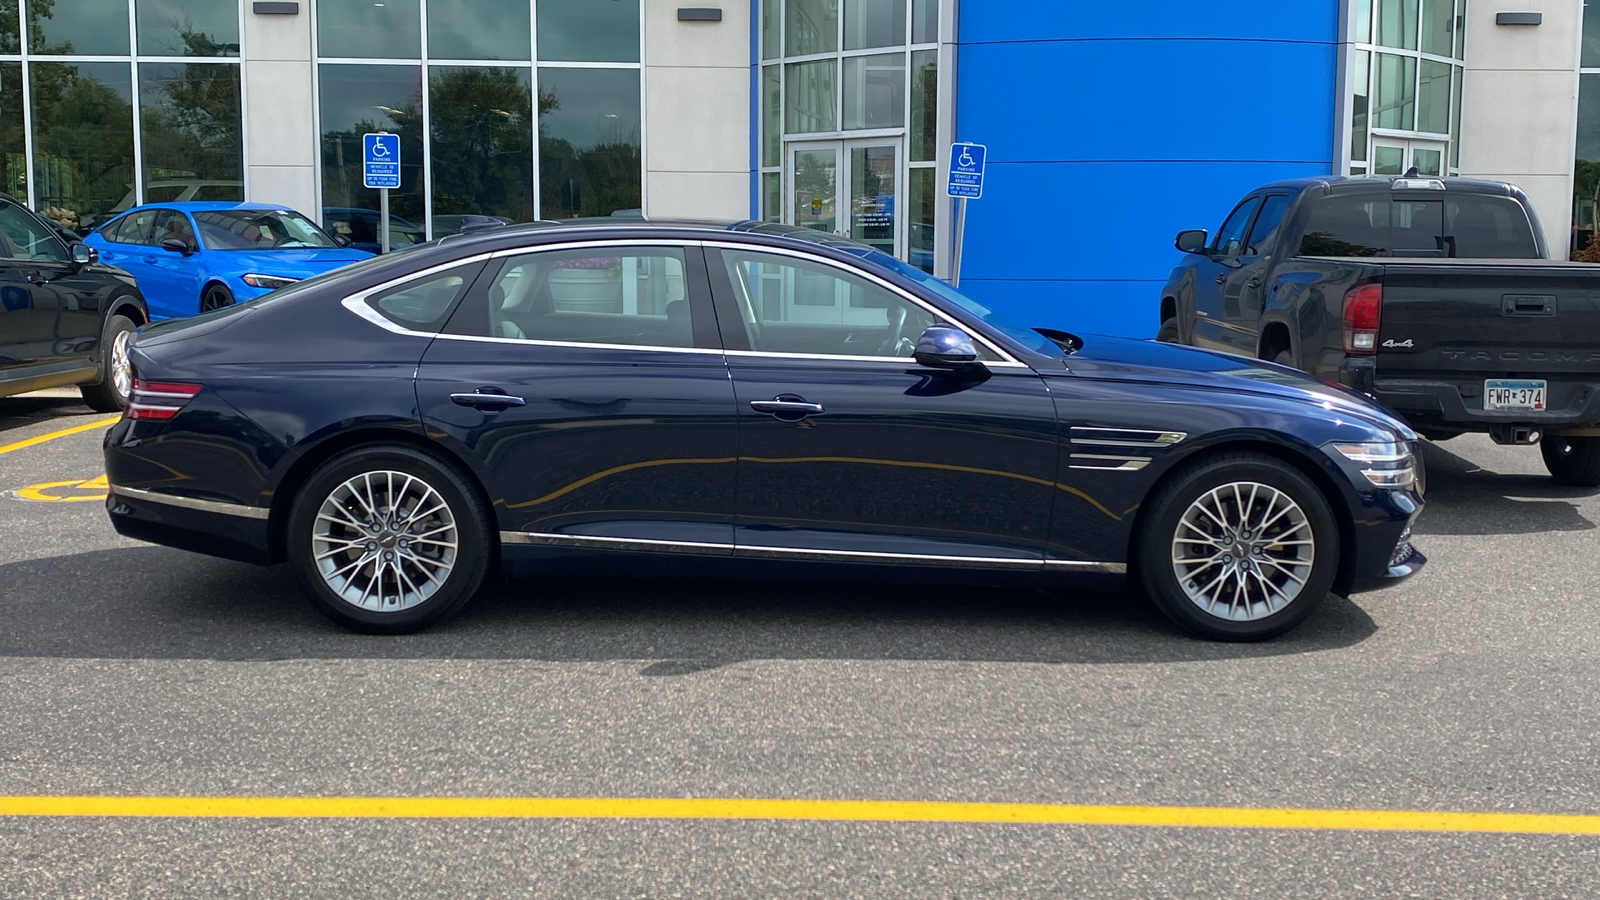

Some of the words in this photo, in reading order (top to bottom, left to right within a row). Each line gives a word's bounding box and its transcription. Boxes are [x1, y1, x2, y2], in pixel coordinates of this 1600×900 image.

[1381, 339, 1414, 348] 4x4
[1441, 350, 1600, 362] TACOMA
[1488, 389, 1510, 404] FWR
[1519, 389, 1541, 404] 374
